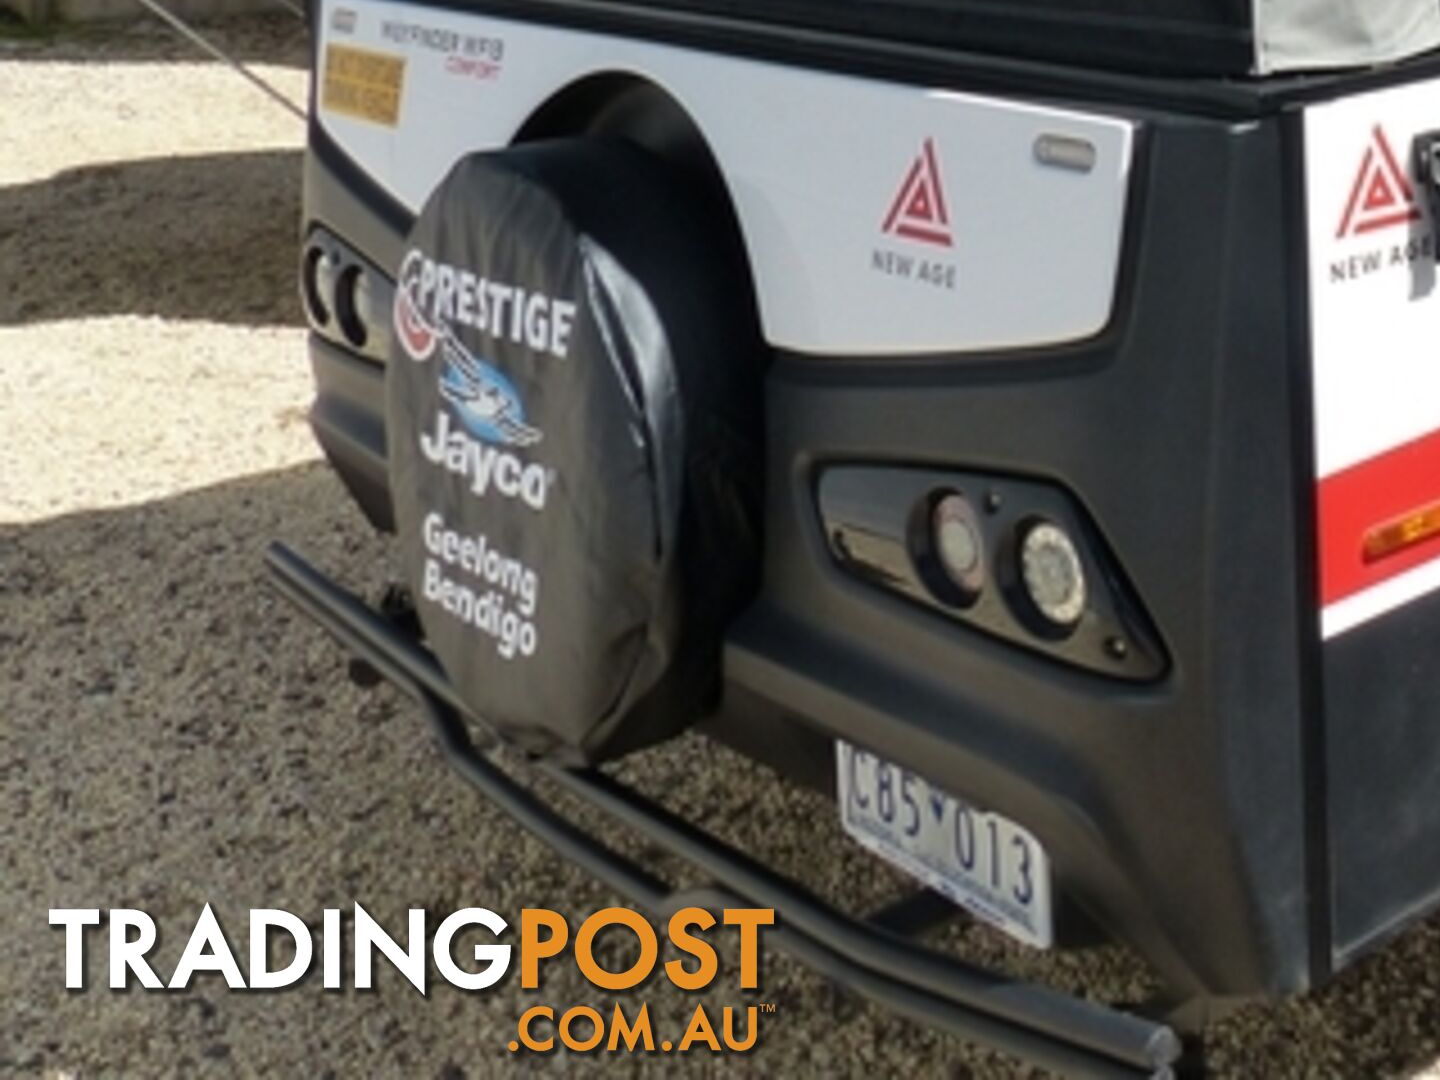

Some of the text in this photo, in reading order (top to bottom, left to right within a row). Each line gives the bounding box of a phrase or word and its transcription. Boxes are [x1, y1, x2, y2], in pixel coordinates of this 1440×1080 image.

[420, 258, 577, 359] PRESTIGE
[871, 247, 957, 290] NEW AGE
[1329, 234, 1433, 284] NEW AGE
[420, 411, 548, 510] Jayco
[423, 513, 538, 616] Geelong
[423, 560, 537, 660] Bendigo
